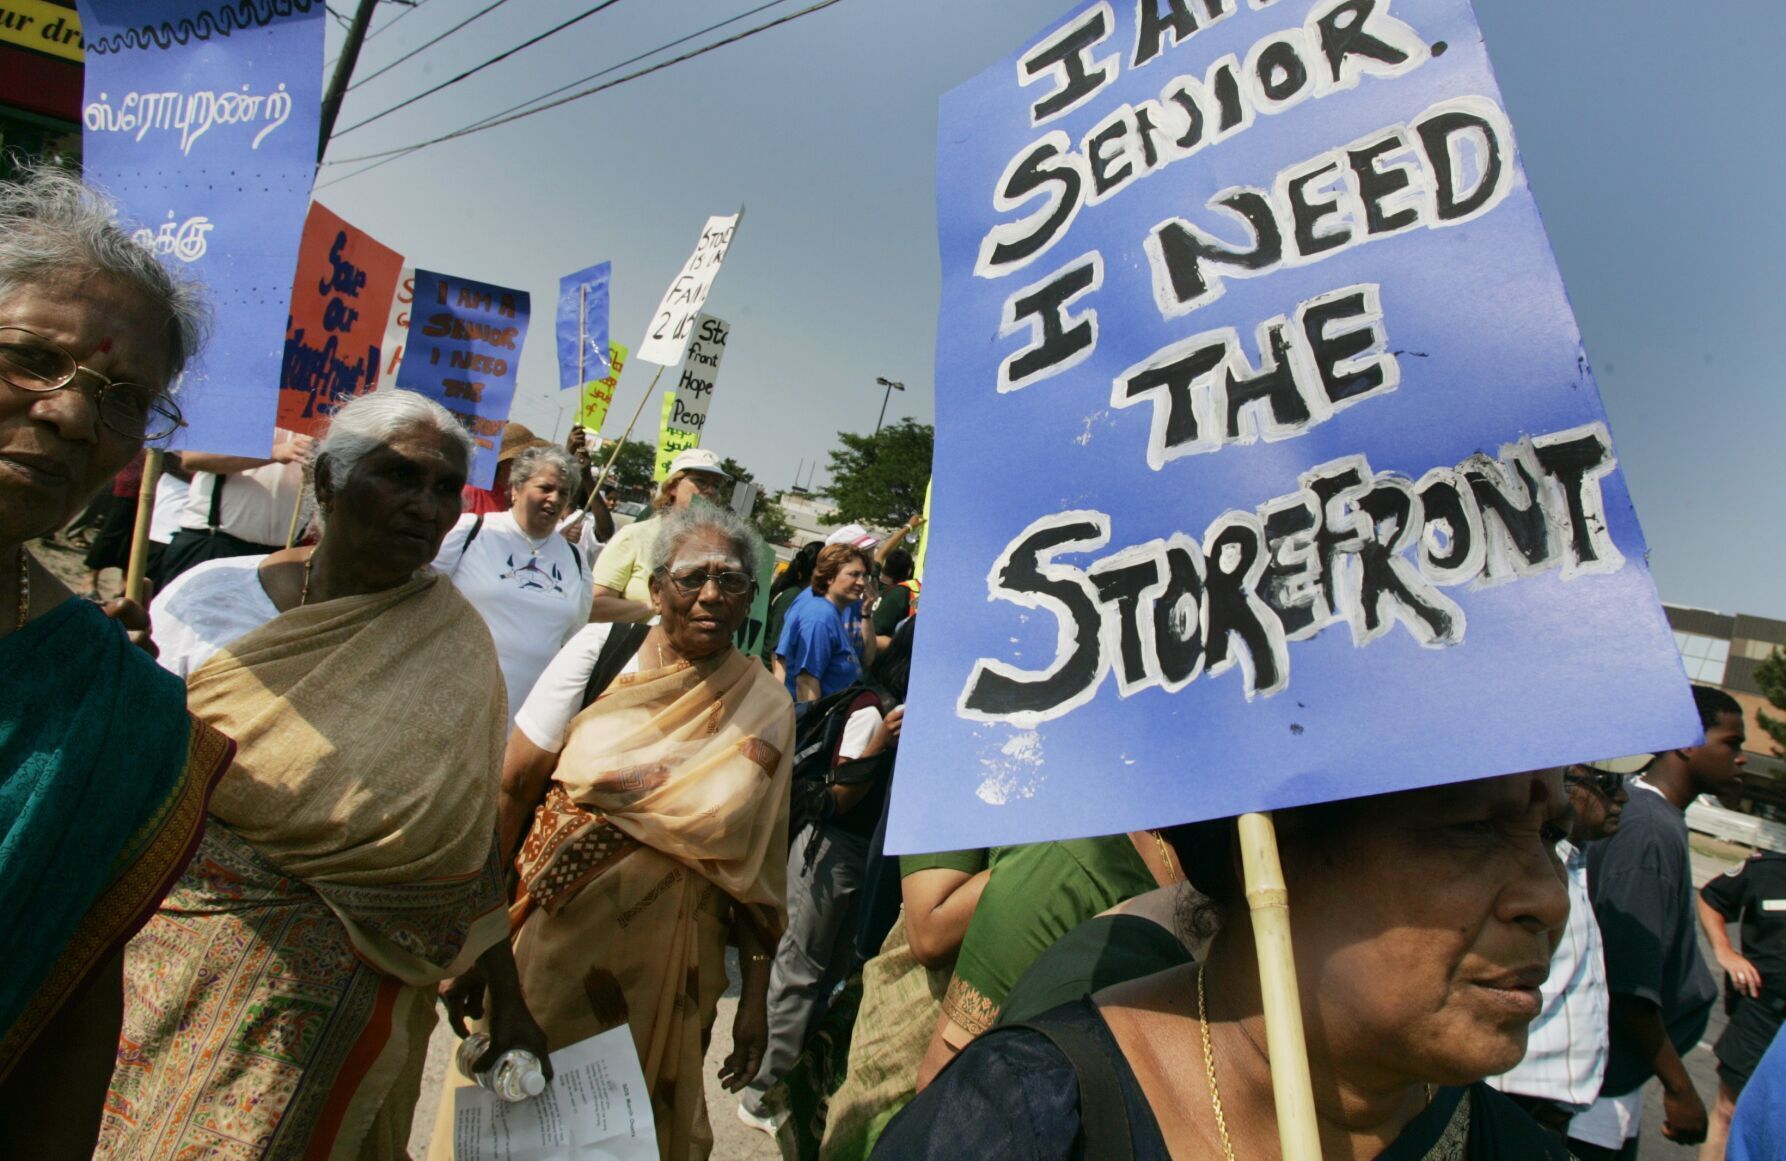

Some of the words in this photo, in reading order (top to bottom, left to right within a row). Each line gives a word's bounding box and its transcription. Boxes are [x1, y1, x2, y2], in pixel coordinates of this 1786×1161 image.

[41, 17, 84, 49] dr
[1017, 3, 1121, 127] I
[1128, 0, 1286, 70] A
[997, 250, 1104, 393] I
[1143, 95, 1513, 320] NEED
[437, 281, 449, 305] I
[653, 311, 671, 339] 2
[679, 370, 714, 399] Hope
[1110, 283, 1401, 471] THE
[957, 421, 1626, 725] STOREFRONT
